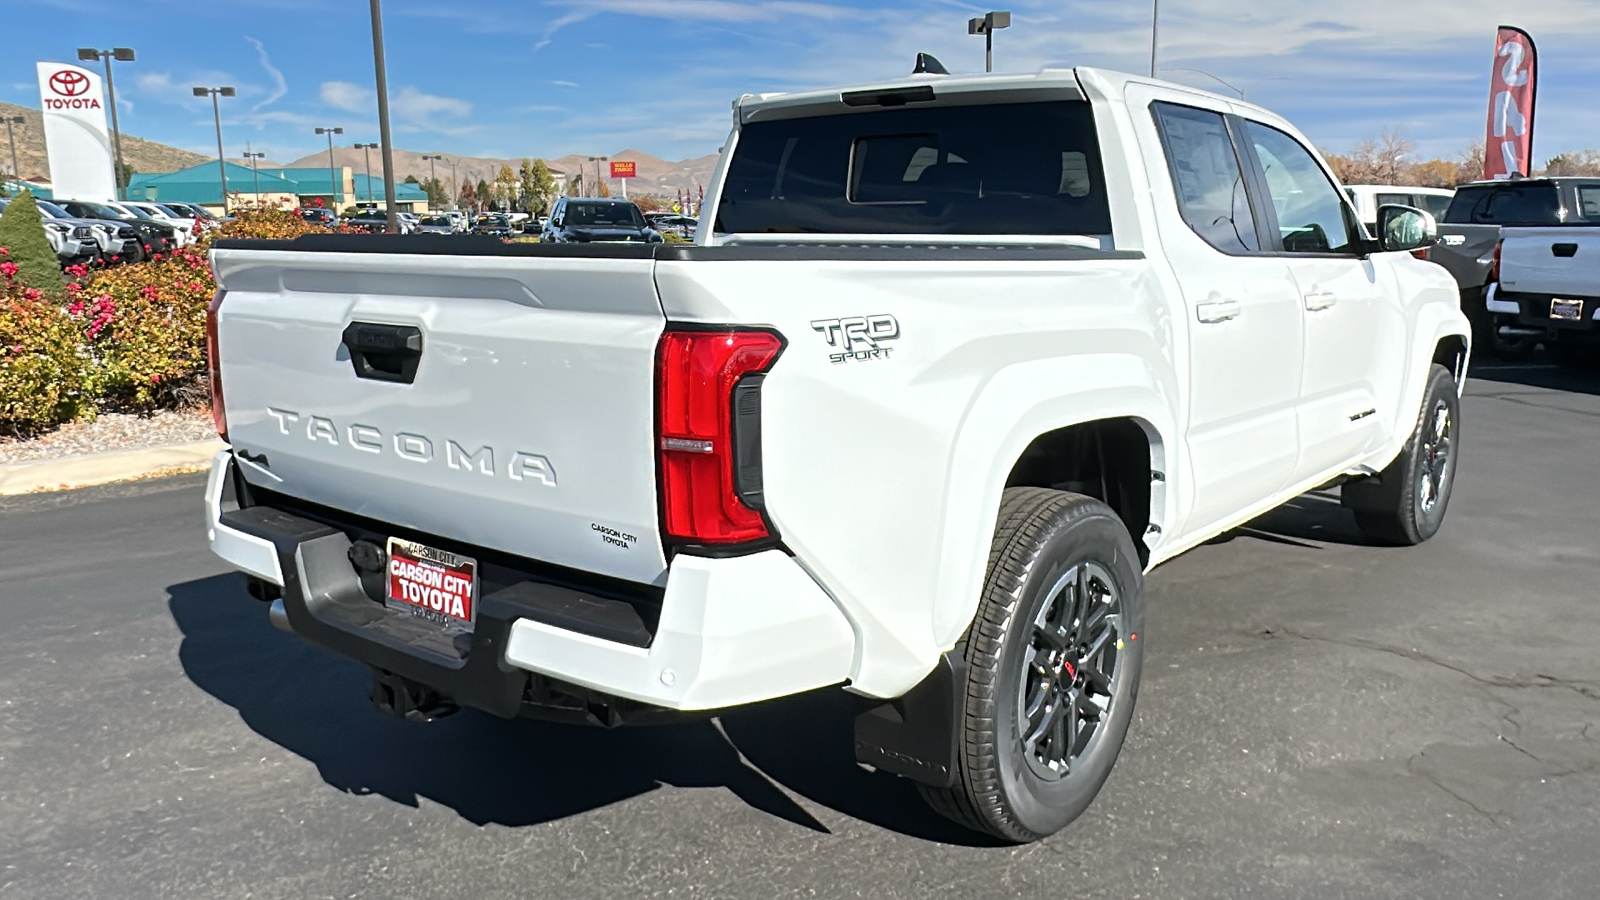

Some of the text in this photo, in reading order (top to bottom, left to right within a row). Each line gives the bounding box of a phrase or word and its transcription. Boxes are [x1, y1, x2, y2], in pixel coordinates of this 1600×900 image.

[44, 98, 101, 109] TOYOTA
[810, 313, 901, 352] TRD
[829, 347, 894, 364] SPORT
[266, 406, 558, 487] TACOMA
[591, 522, 638, 543] CARSON CITY
[602, 534, 629, 549] TOYOTA
[408, 542, 456, 564] CARSON CITY
[390, 559, 443, 589] CARSON
[443, 575, 473, 598] CITY
[398, 577, 466, 618] TOYOTA
